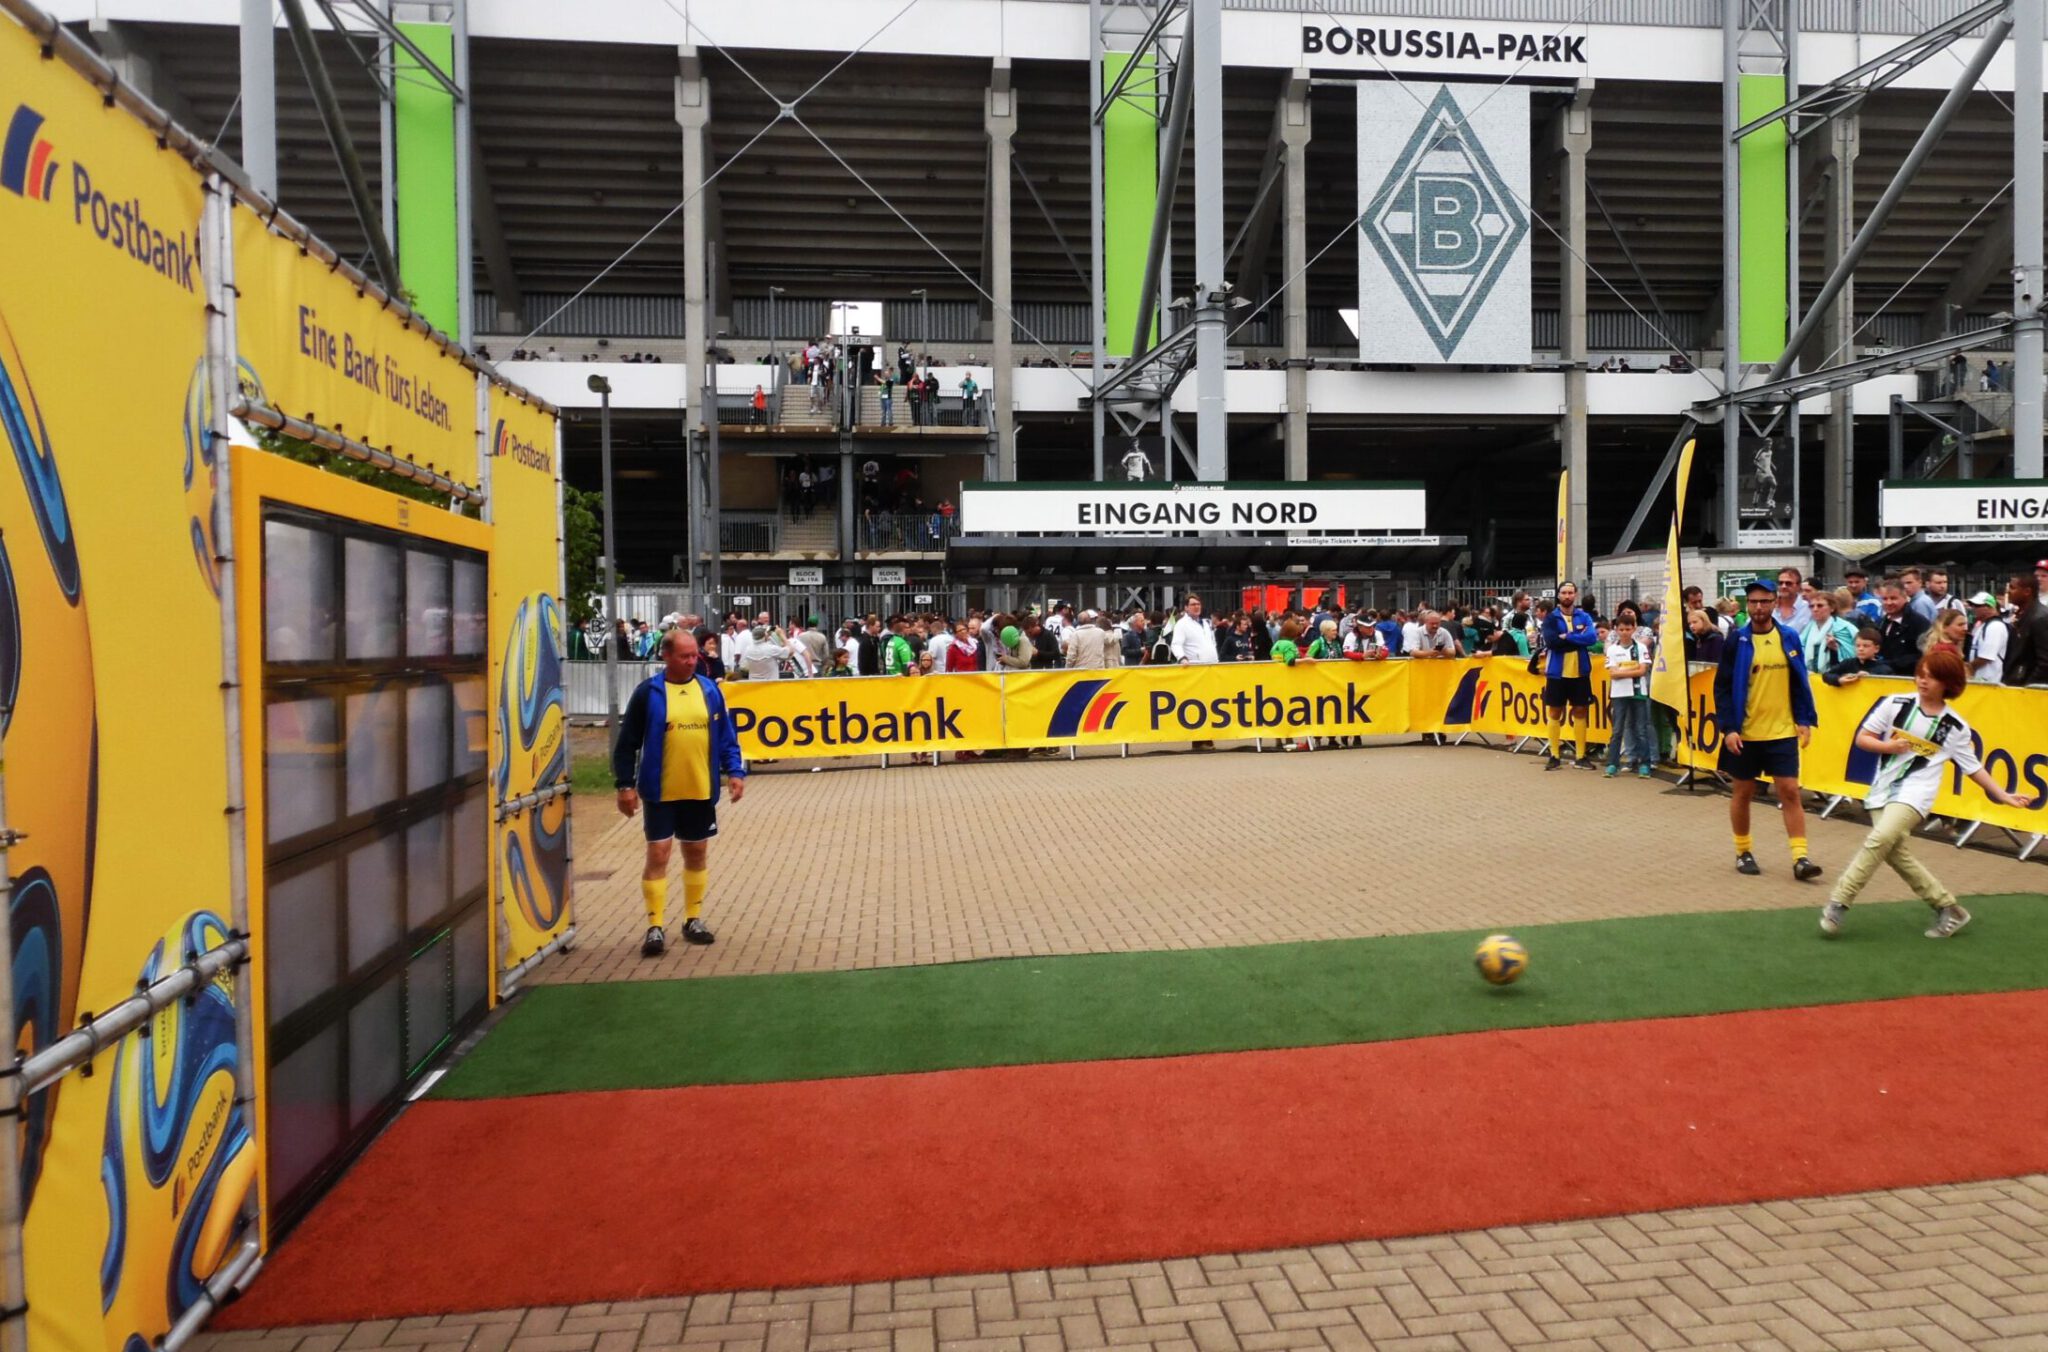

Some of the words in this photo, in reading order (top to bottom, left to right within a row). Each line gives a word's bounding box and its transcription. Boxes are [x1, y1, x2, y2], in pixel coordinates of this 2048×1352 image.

[1302, 26, 1587, 63] BORUSSIA-PARK
[72, 160, 194, 293] Postbank
[298, 304, 337, 370] Eine
[343, 331, 381, 395] Bank
[385, 354, 411, 410] fürs
[414, 374, 452, 432] Leben.
[511, 433, 552, 474] Postbank
[1077, 502, 1221, 525] EINGANG
[1232, 502, 1318, 524] NORD
[728, 697, 964, 748] Postbank
[1149, 682, 1373, 730] Postbank
[186, 1090, 227, 1179] Postbank
